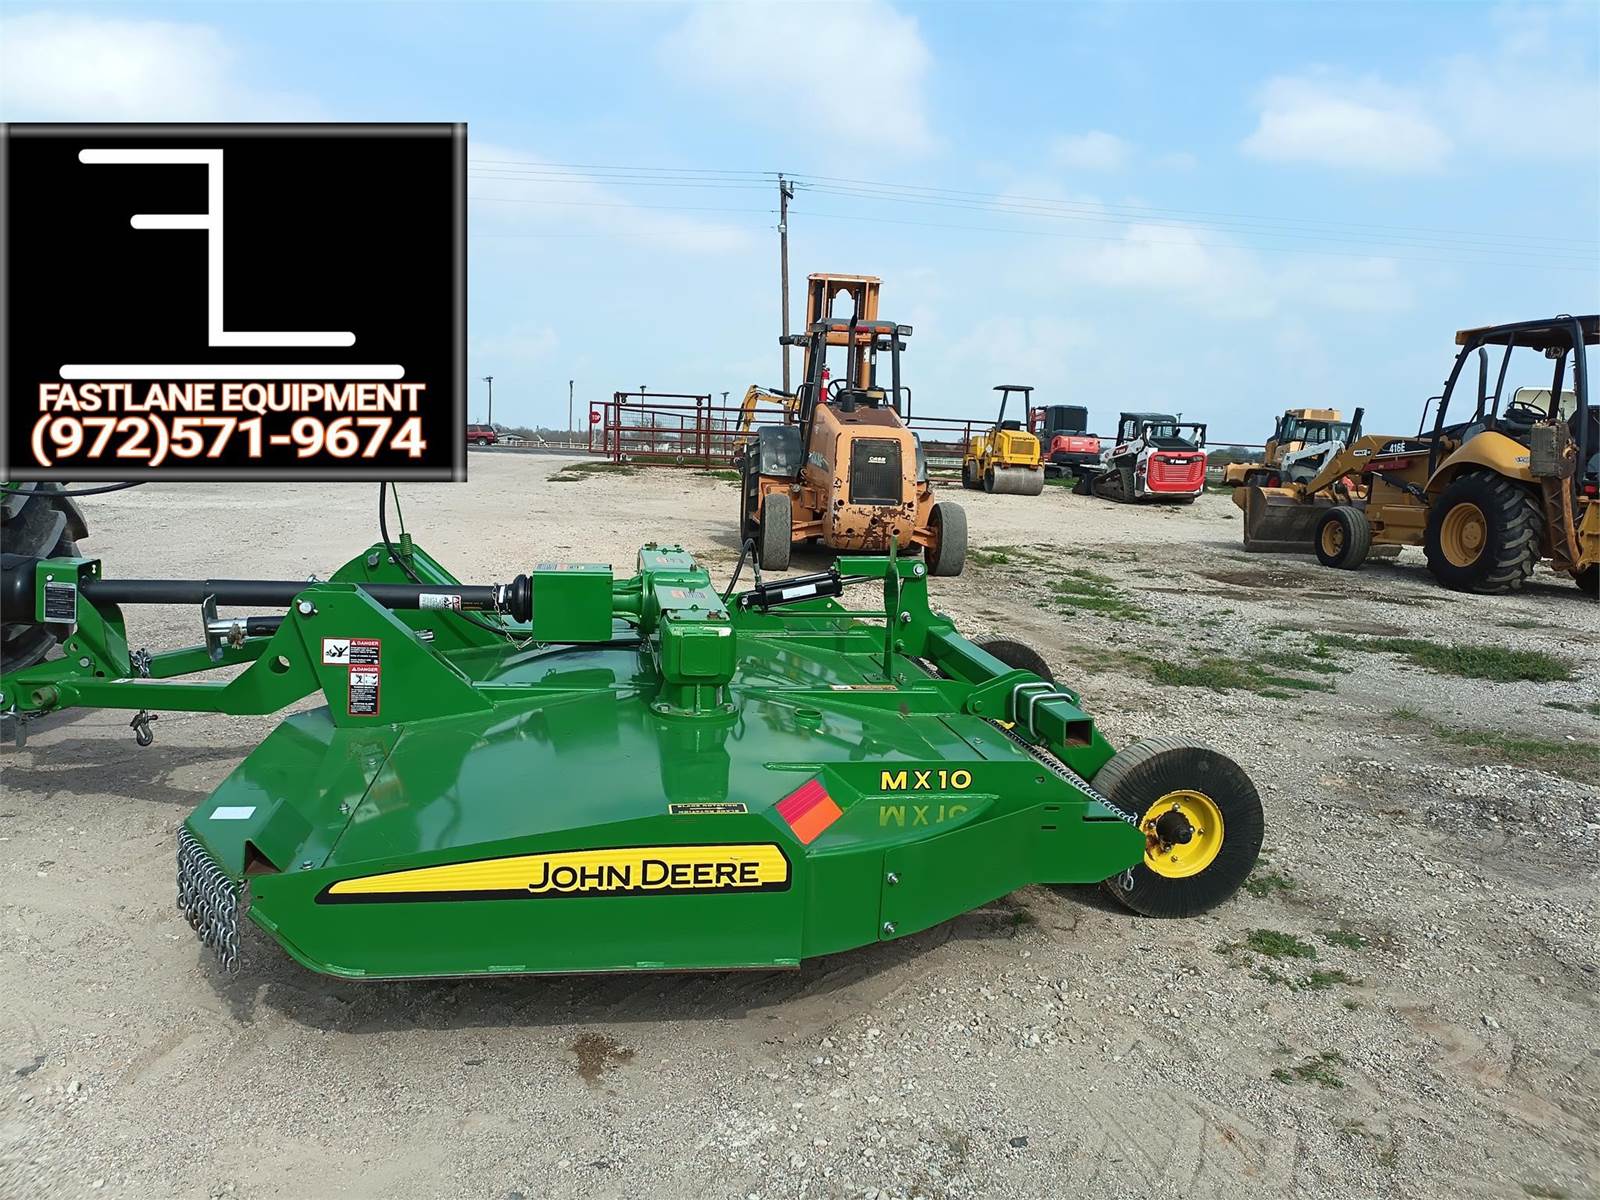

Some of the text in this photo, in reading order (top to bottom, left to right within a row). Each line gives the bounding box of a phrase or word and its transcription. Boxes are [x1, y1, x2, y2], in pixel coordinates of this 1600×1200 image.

[1389, 442, 1405, 453] 416E
[528, 859, 760, 889] JOHN DEERE
